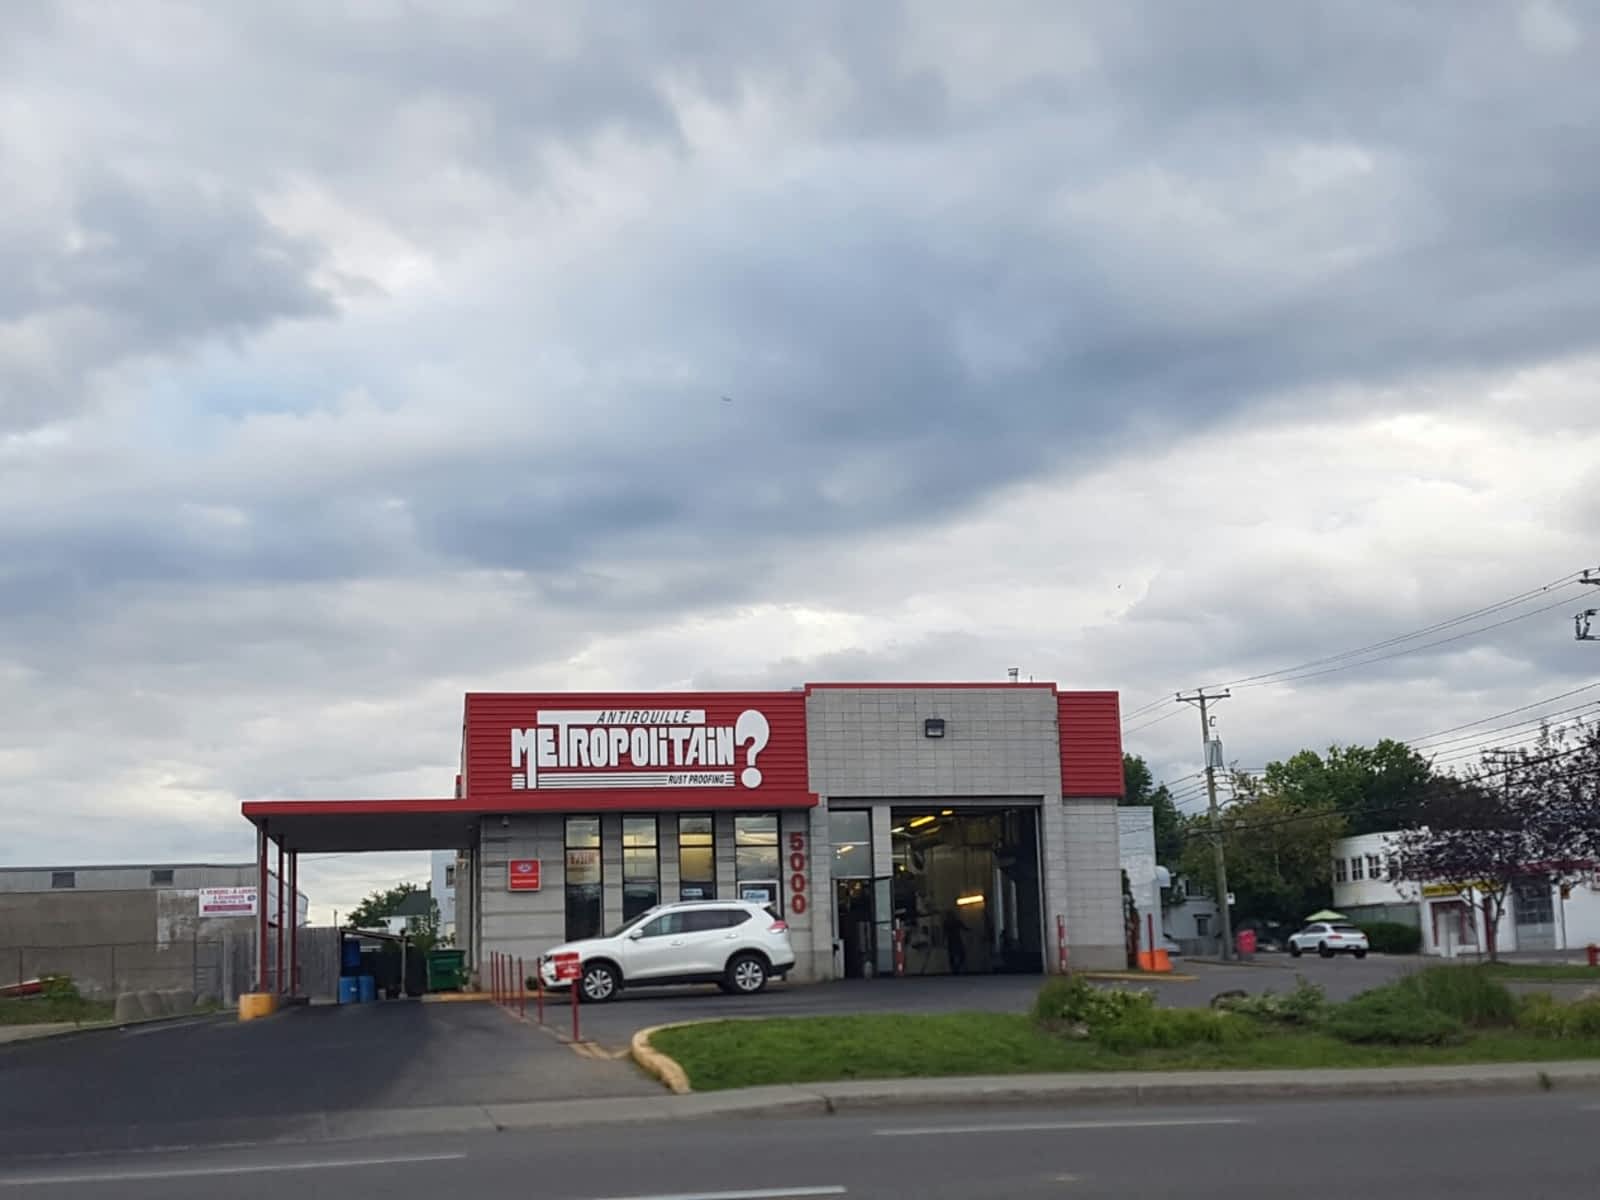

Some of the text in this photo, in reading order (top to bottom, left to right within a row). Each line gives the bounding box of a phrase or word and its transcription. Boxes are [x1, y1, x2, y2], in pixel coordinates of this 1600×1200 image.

[597, 711, 690, 724] ANTIROUILLE
[668, 774, 724, 785] RUST PROOFING
[789, 832, 806, 914] 5000
